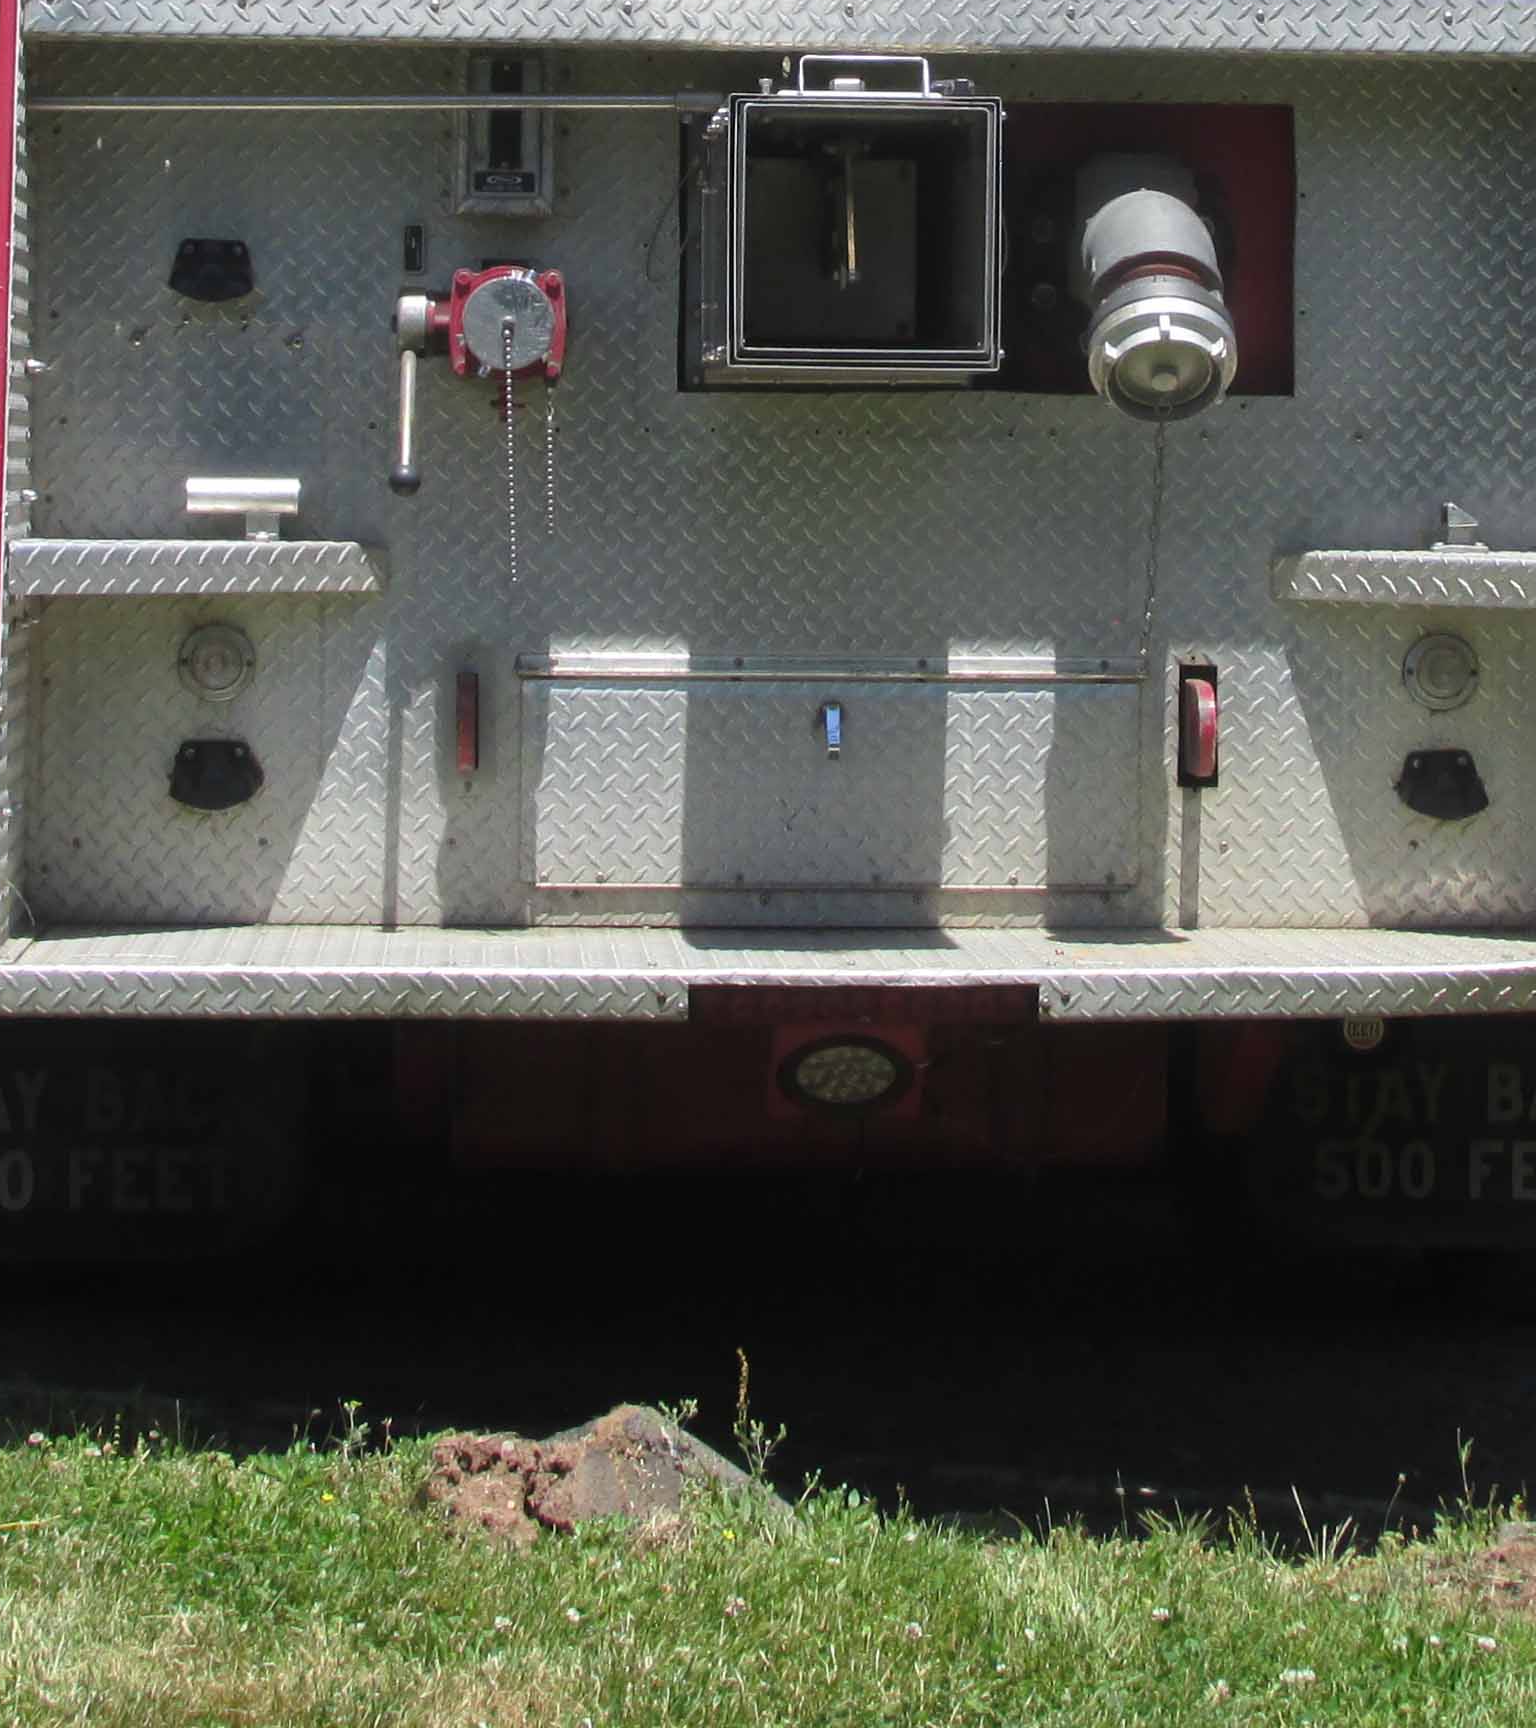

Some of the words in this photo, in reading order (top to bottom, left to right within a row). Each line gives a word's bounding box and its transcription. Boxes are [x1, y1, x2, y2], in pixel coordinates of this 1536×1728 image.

[1293, 1061, 1450, 1124] STAY
[65, 1147, 234, 1212] FEET
[1312, 1139, 1438, 1201] 500
